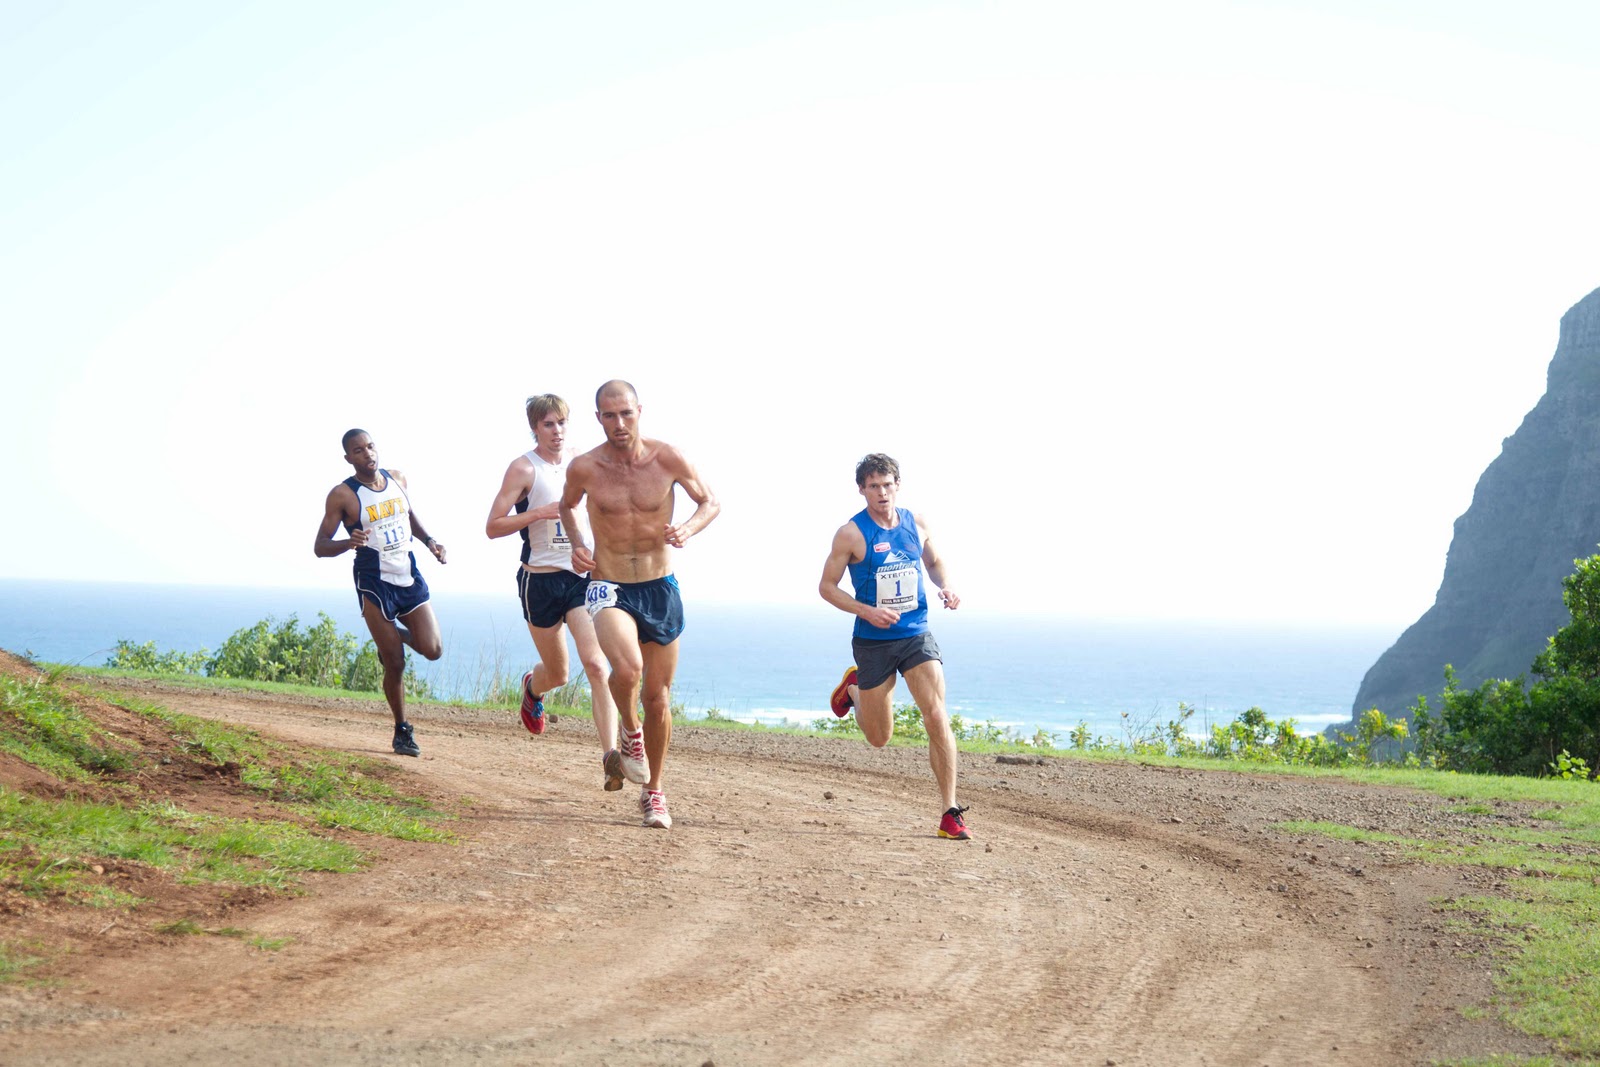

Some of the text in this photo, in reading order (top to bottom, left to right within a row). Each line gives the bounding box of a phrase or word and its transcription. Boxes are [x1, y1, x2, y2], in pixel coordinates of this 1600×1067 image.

[366, 498, 405, 522] NAVY
[384, 526, 404, 544] 113
[877, 561, 917, 572] montrail
[895, 580, 901, 596] 1
